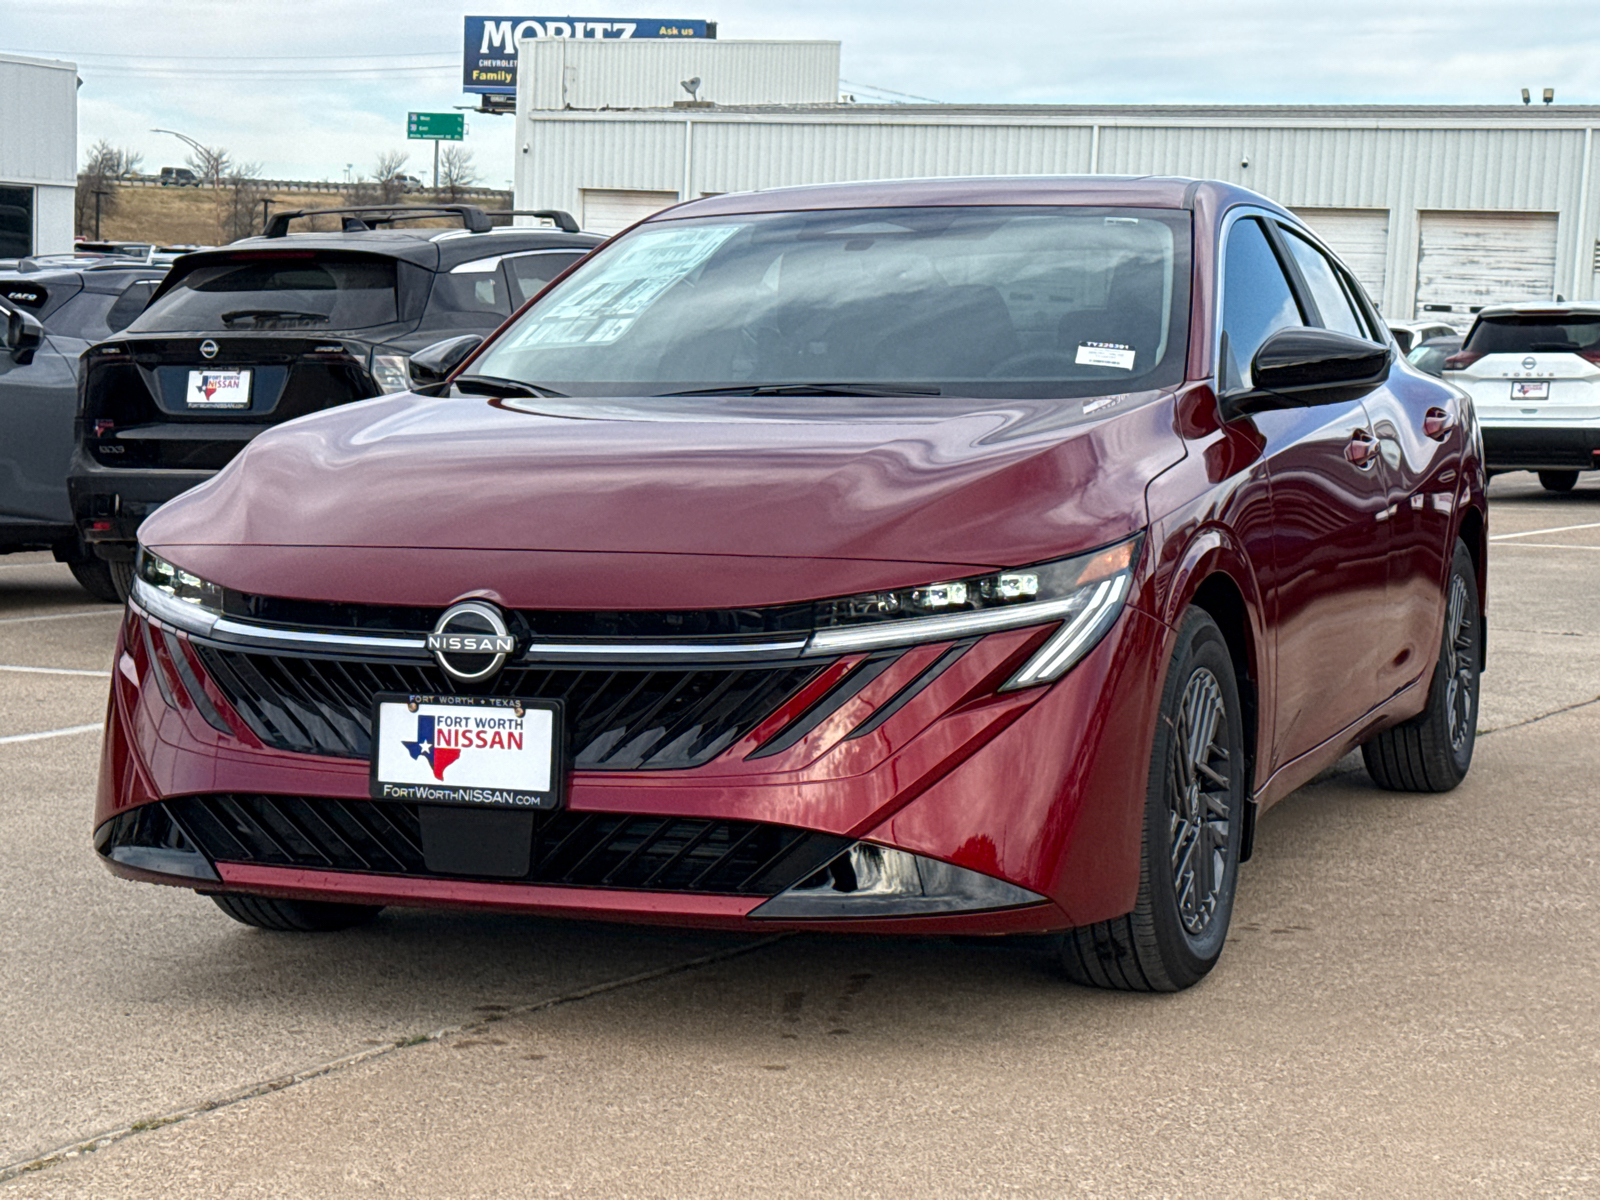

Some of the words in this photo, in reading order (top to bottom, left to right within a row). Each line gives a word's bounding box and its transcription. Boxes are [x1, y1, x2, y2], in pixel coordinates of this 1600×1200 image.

[659, 26, 677, 36] Ask
[679, 27, 694, 36] us
[479, 59, 518, 68] CHEVROLET
[472, 70, 512, 83] Family
[208, 380, 240, 389] NISSAN
[428, 636, 512, 651] NISSAN
[409, 695, 435, 704] FORT
[439, 696, 475, 705] WORTH
[489, 698, 522, 708] TEXAS
[436, 715, 472, 728] FORT
[474, 717, 524, 731] WORTH
[436, 728, 523, 751] NISSAN
